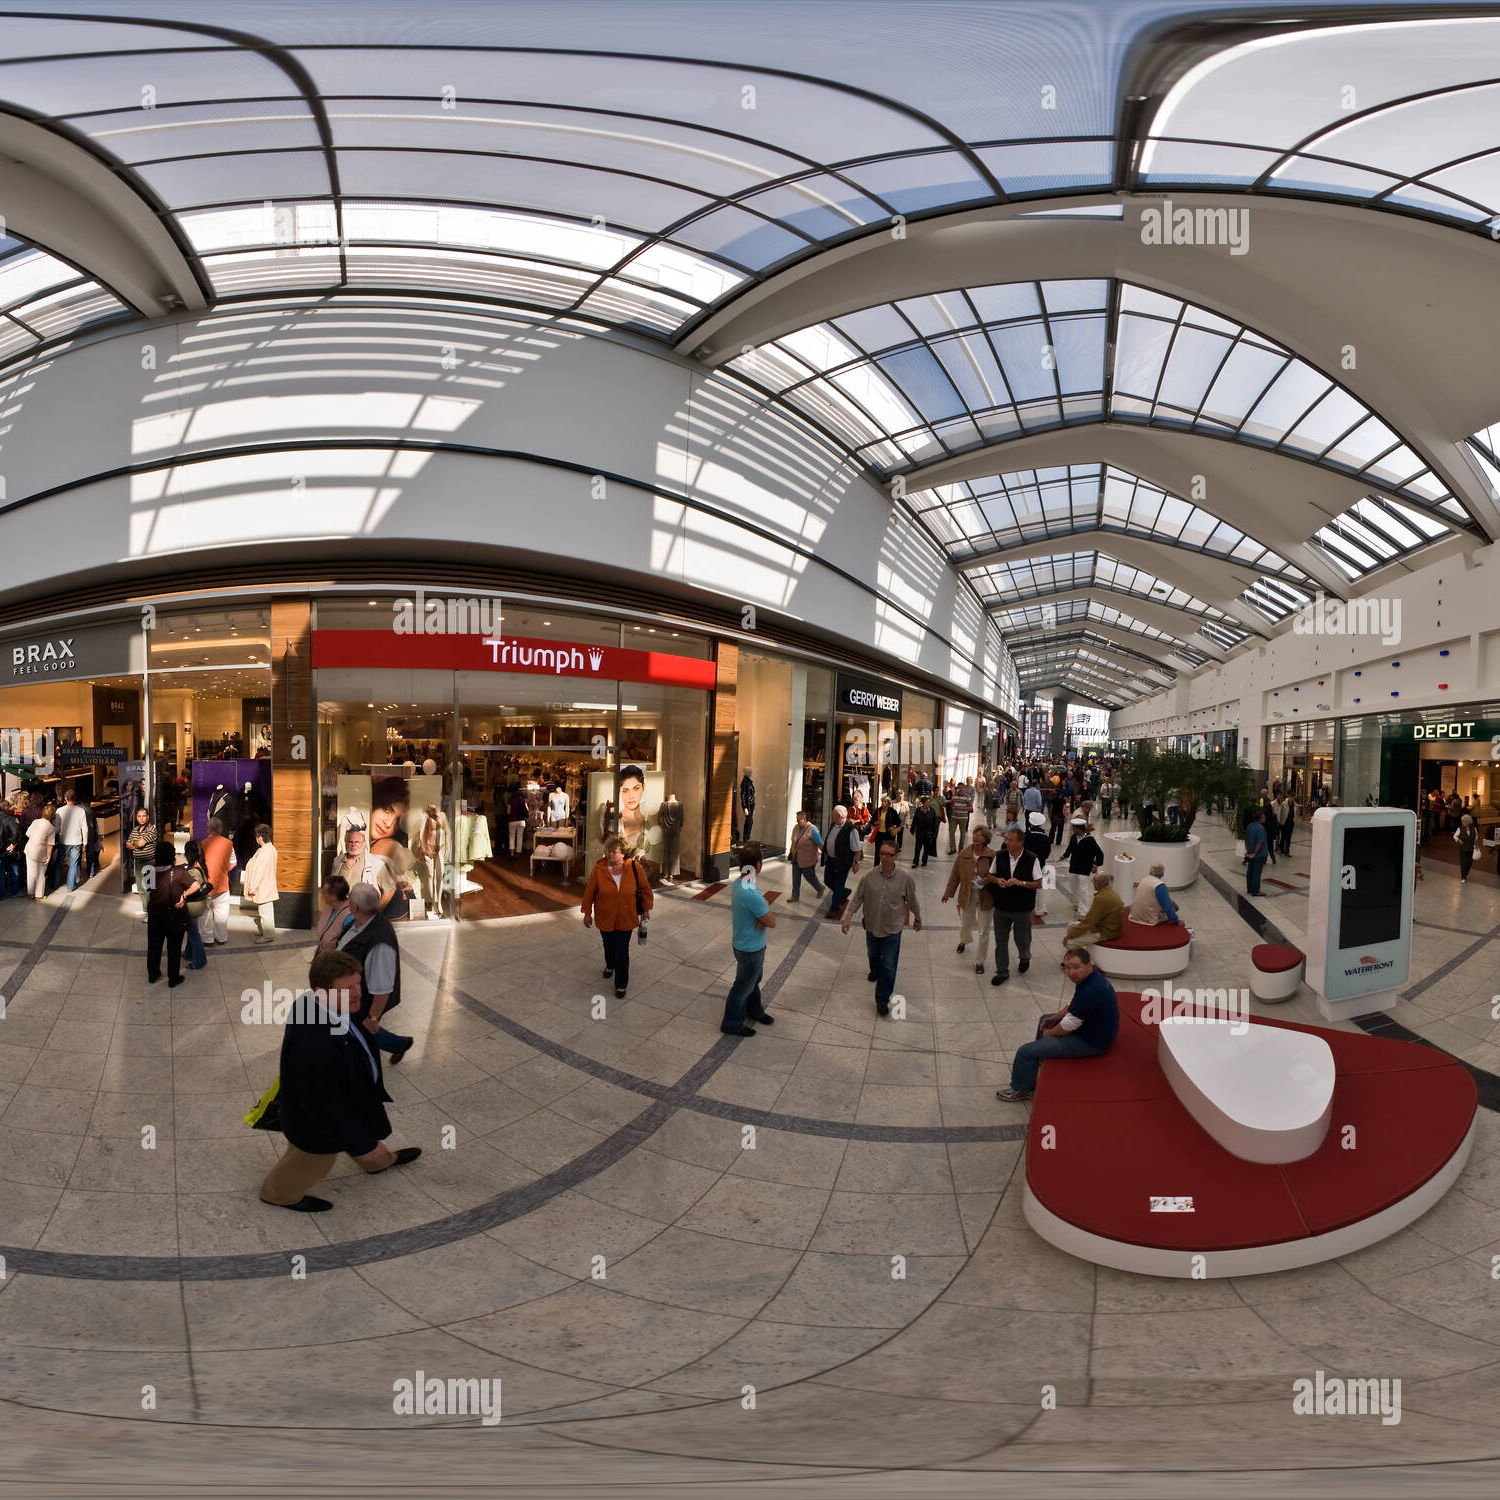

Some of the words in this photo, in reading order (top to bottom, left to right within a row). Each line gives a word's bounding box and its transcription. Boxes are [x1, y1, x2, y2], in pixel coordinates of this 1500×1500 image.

[12, 638, 74, 665] BRAX
[486, 640, 584, 673] Triumph
[13, 667, 38, 676] FEEL
[44, 660, 75, 671] GOOD
[849, 689, 877, 707] GERRY
[876, 695, 900, 712] WEBER
[1413, 722, 1475, 738] DEPOT
[1344, 960, 1394, 976] WATERFRONT
